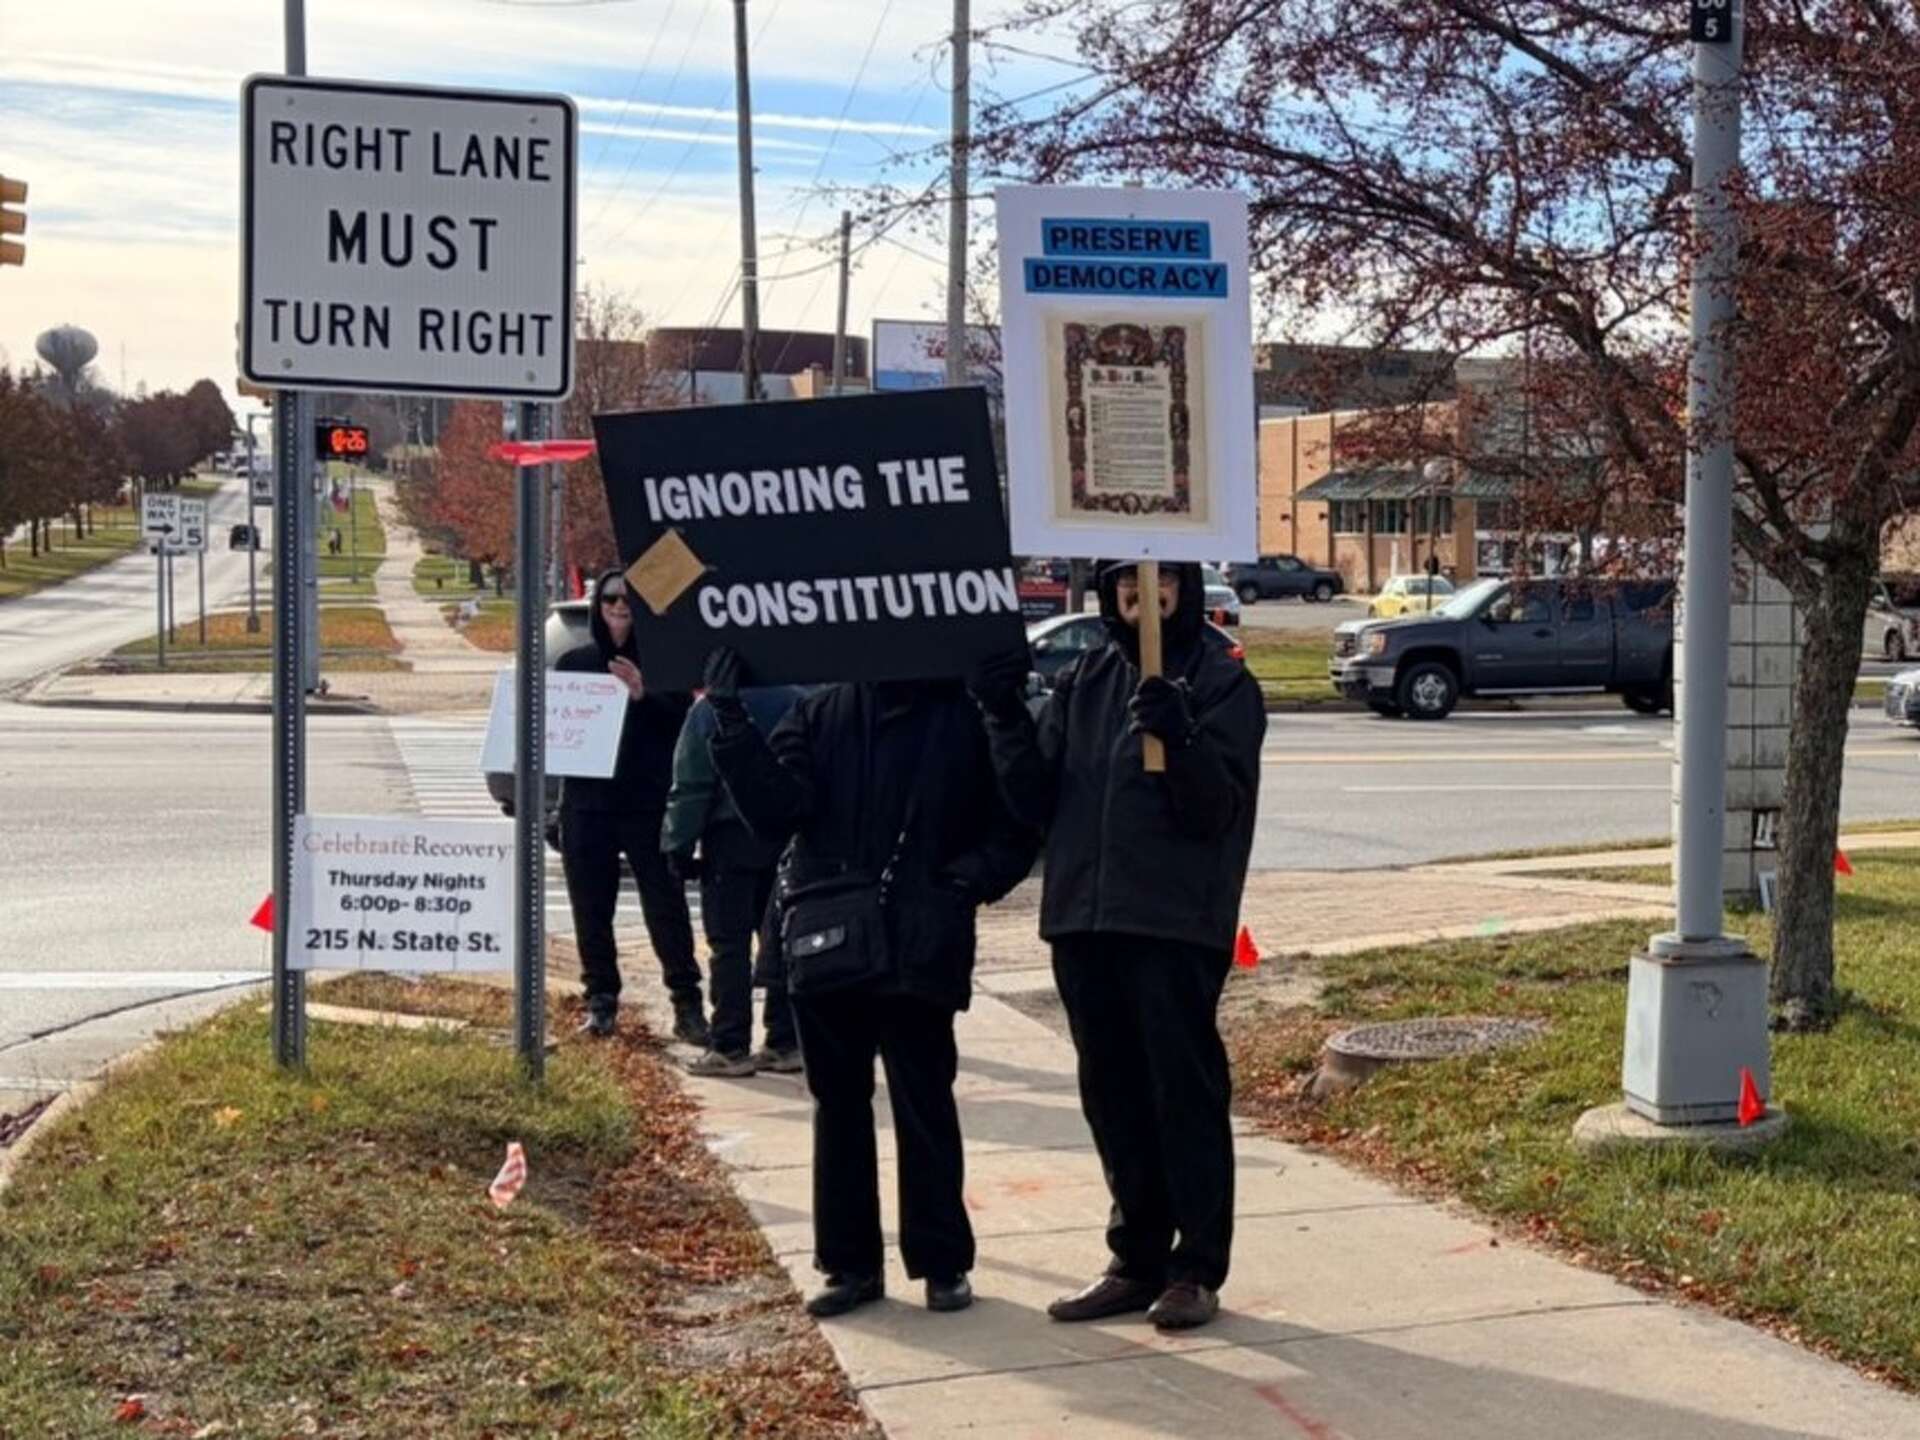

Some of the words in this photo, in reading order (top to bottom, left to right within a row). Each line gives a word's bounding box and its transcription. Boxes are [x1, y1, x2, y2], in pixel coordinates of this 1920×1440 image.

[1704, 17, 1719, 38] 5
[271, 121, 411, 173] RIGHT
[433, 132, 551, 182] LANE
[328, 209, 498, 272] MUST
[1050, 226, 1202, 253] PRESERVE
[1034, 264, 1222, 293] DEMOCRACY
[263, 299, 390, 349] TURN
[419, 308, 553, 357] RIGHT
[644, 469, 865, 521] IGNORING
[878, 456, 970, 506] THE
[146, 510, 175, 520] WAY
[147, 497, 174, 508] ONE
[699, 567, 1018, 629] CONSTITUTION
[328, 870, 418, 890] Thursday
[423, 873, 486, 892] Nights
[414, 896, 472, 915] 8:30p
[305, 928, 349, 950] 215
[357, 929, 384, 950] N.
[392, 930, 460, 952] State
[467, 931, 500, 953] St.
